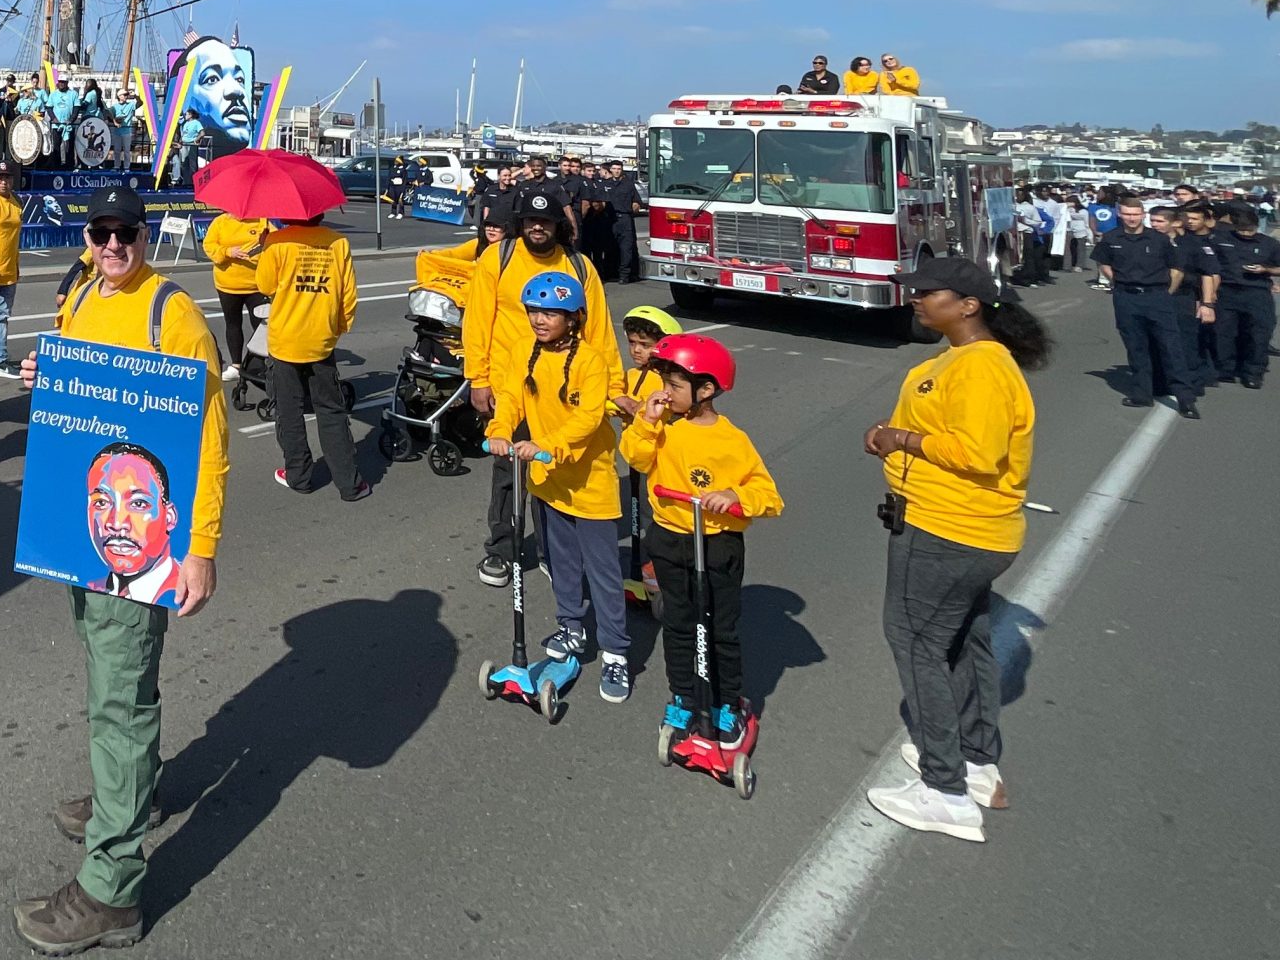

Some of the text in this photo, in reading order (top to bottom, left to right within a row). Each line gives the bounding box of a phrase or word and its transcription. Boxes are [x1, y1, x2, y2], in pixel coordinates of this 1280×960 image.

[84, 175, 100, 188] San
[39, 337, 198, 380] Injustice anywhere
[35, 371, 199, 417] is a threat to justice
[31, 409, 129, 440] everywhere.
[15, 562, 37, 573] MARTIN
[36, 566, 58, 577] LUTHER
